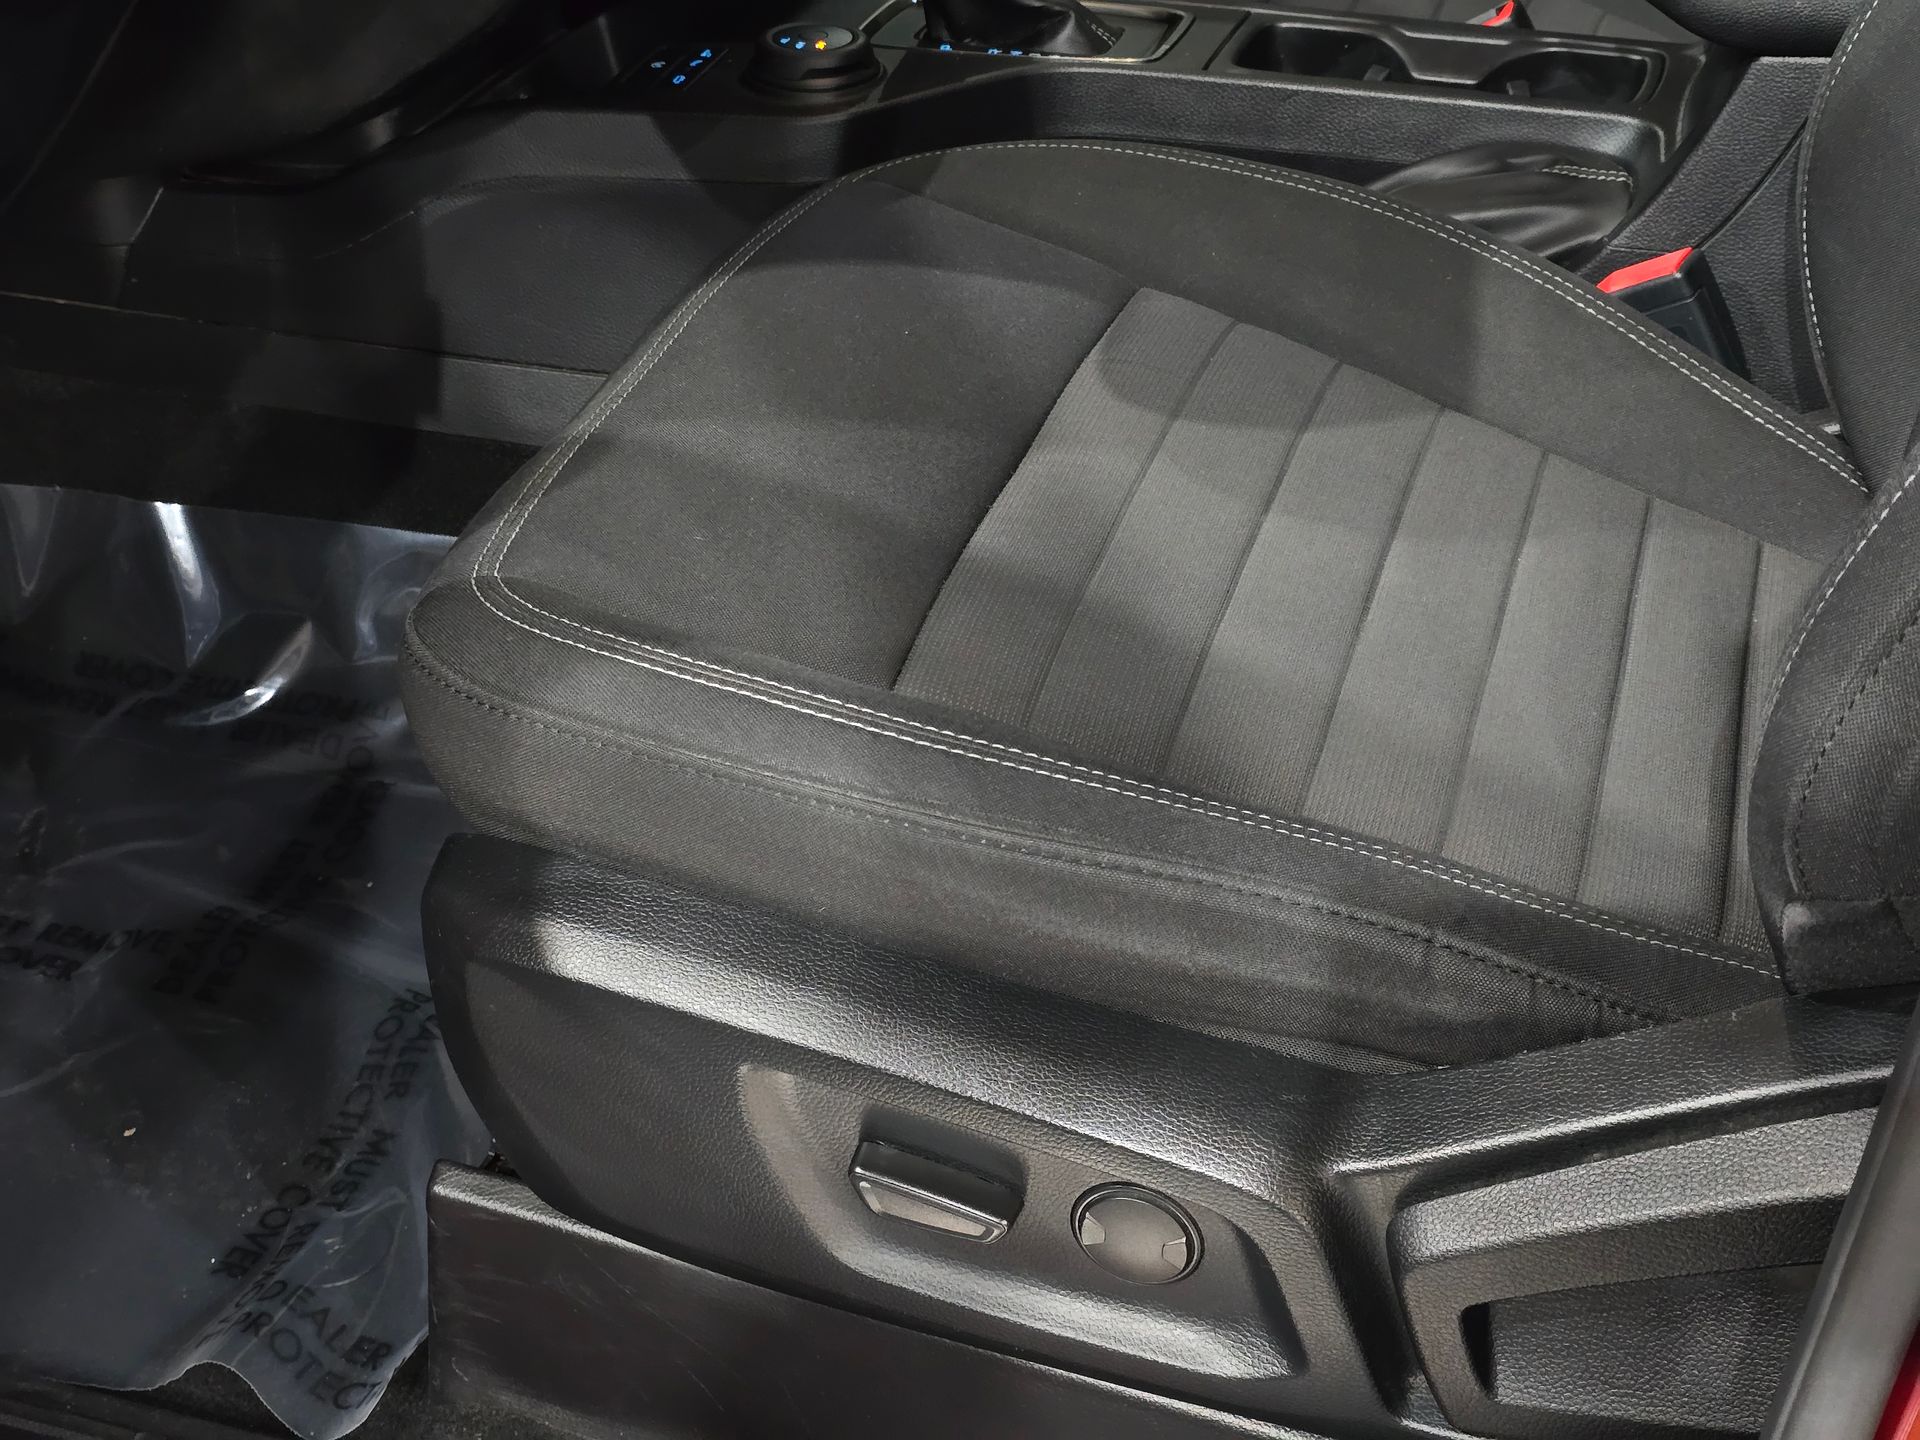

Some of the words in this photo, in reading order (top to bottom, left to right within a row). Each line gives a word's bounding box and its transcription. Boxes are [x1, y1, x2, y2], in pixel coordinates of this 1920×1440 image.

[301, 988, 433, 1174] PROTECTIVE
[316, 1128, 397, 1212] MUST
[210, 1183, 312, 1279] COVER
